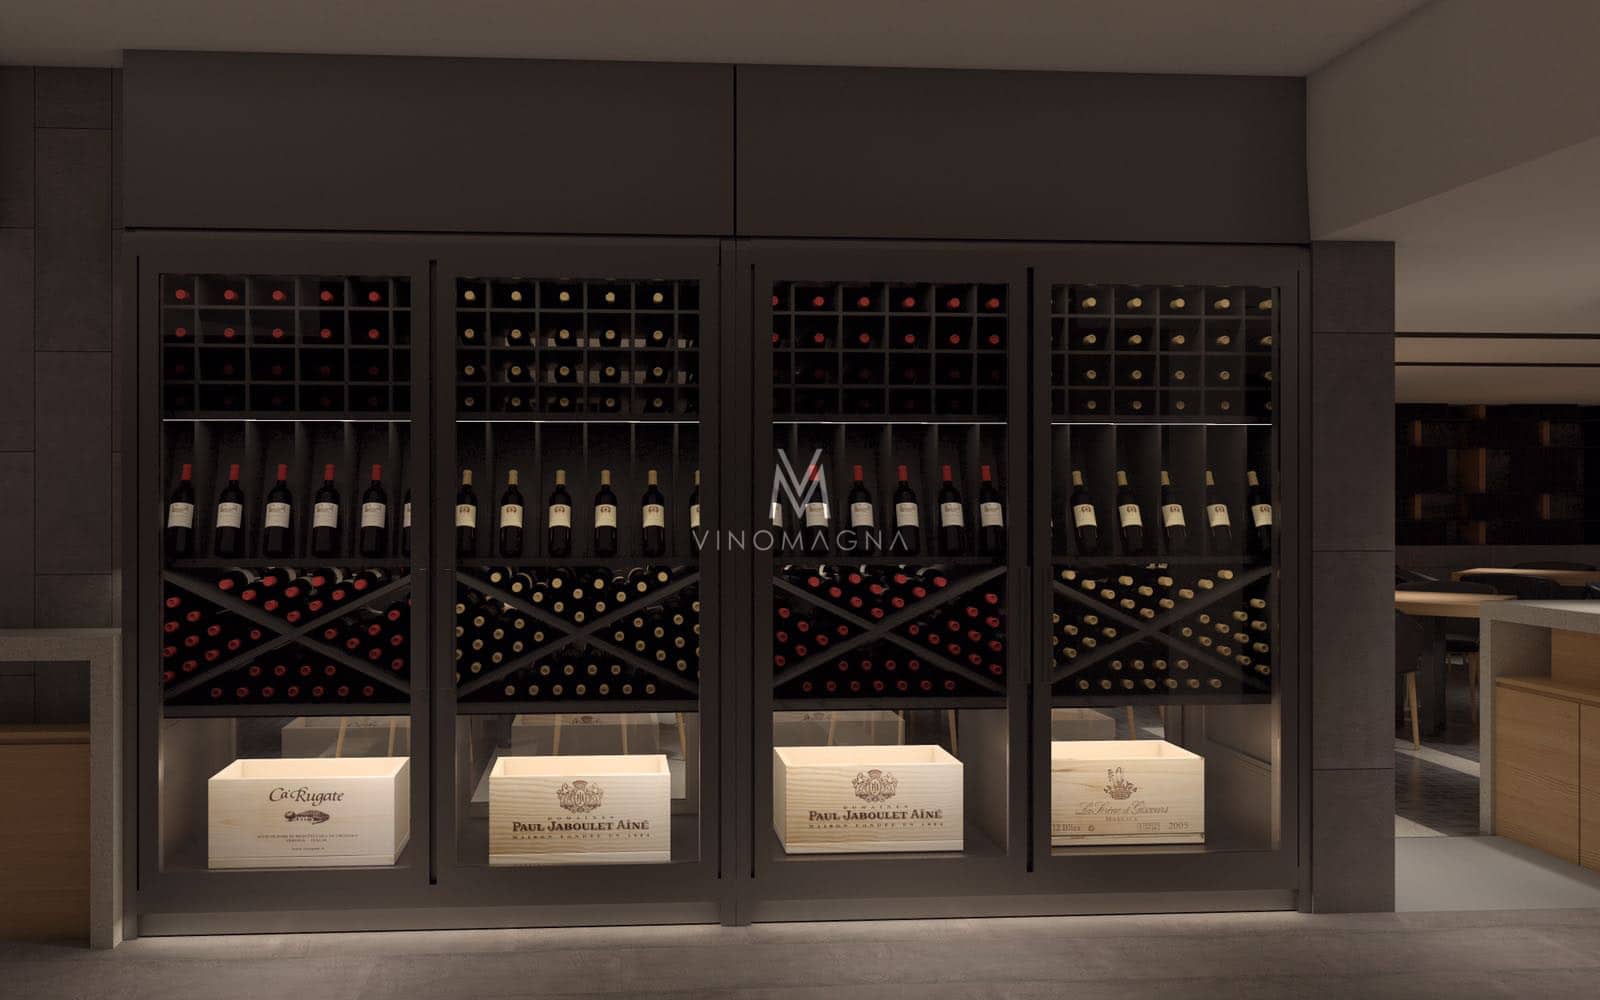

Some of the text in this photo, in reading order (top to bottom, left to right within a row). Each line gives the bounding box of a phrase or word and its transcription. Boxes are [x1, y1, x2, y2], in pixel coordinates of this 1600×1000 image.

[808, 810, 841, 821] PAUL
[843, 810, 908, 821] JABOULET
[512, 821, 545, 832] PAUL
[547, 821, 613, 832] JABOULET
